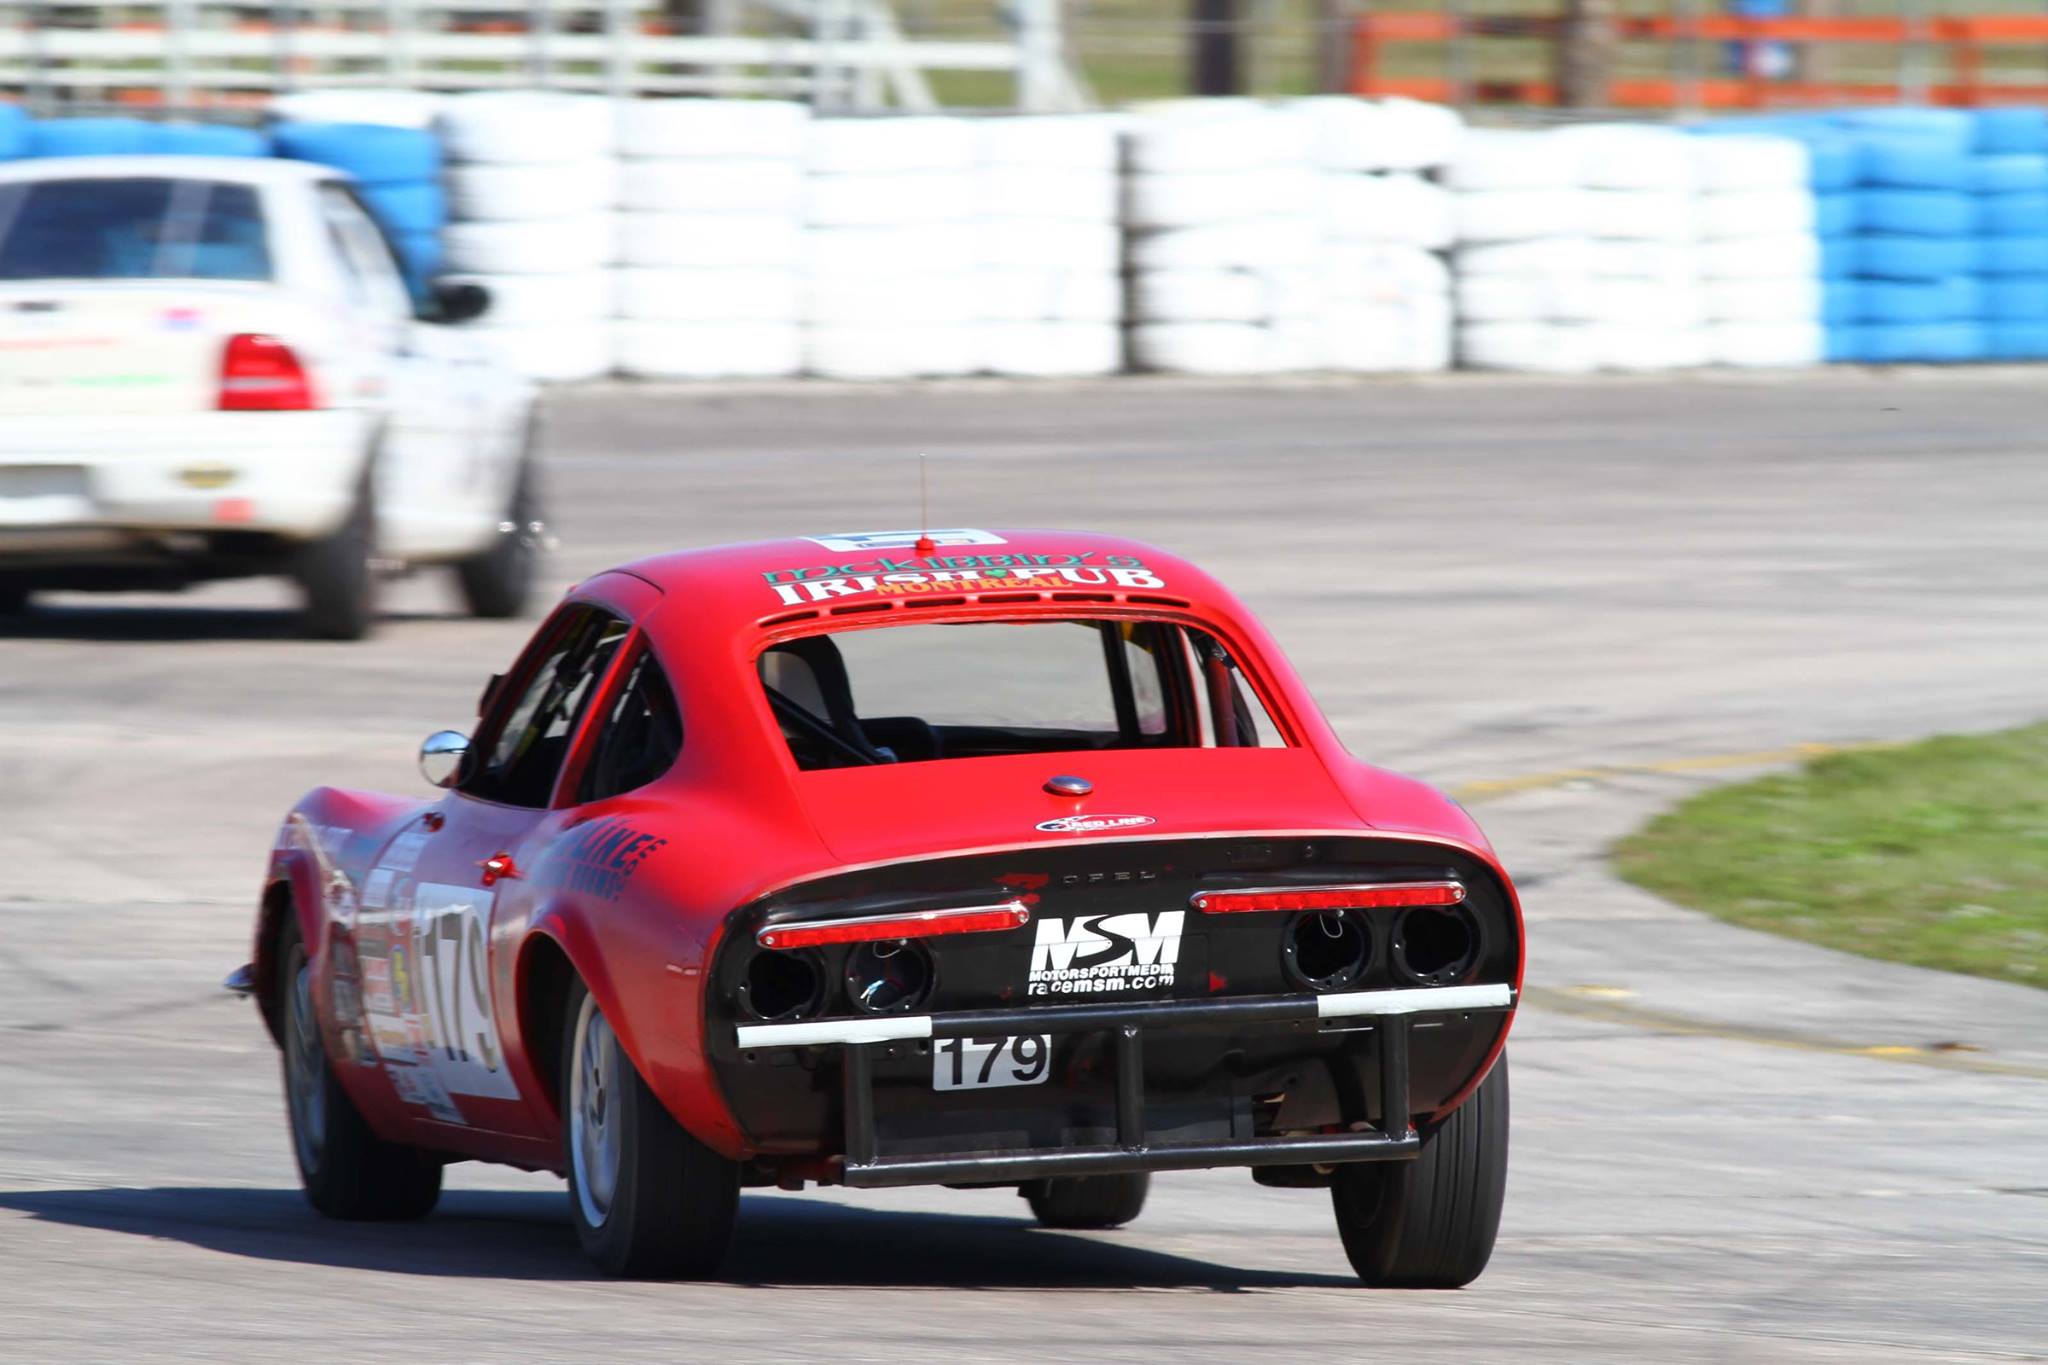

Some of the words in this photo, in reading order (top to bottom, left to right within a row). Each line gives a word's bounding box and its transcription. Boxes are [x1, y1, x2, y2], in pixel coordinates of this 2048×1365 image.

[771, 567, 984, 607] IRISH
[1009, 566, 1166, 589] PUB
[875, 576, 1073, 596] MONTREAL
[1029, 910, 1186, 972] MSM
[1027, 975, 1175, 996] racemsm.com
[940, 1034, 1048, 1086] 179
